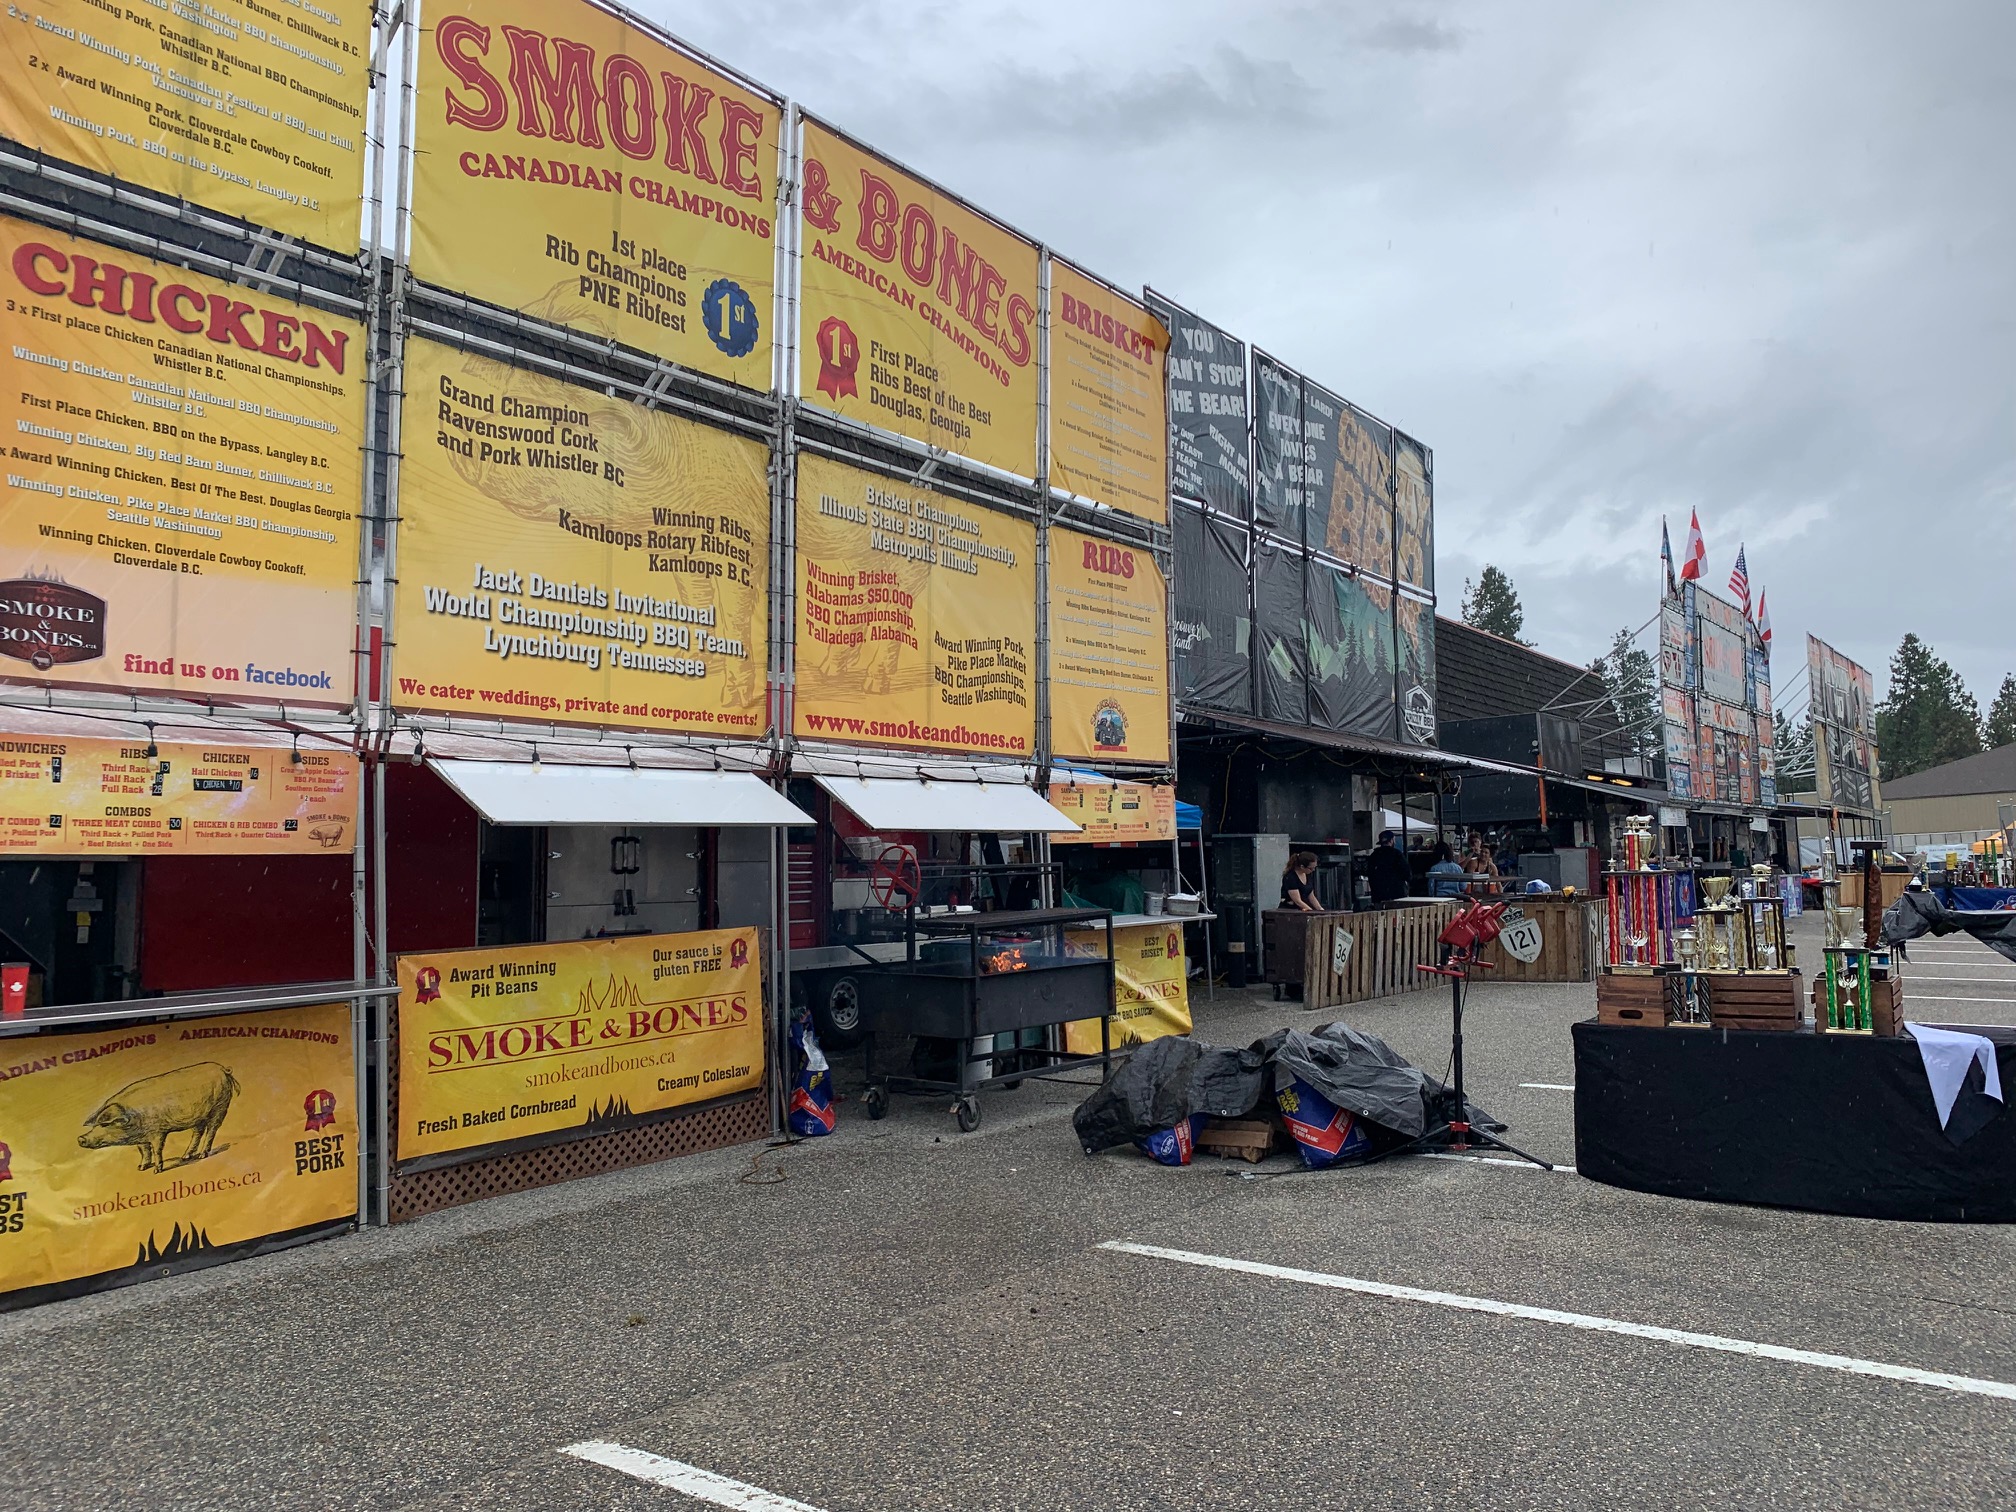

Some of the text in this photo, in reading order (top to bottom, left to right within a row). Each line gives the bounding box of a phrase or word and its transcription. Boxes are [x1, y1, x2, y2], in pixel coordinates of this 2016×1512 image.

[436, 15, 764, 203] SMOKE
[50, 105, 103, 135] Winning
[142, 140, 168, 160] BBQ
[171, 151, 185, 166] on
[189, 153, 207, 172] the
[255, 179, 299, 206] Langley
[301, 191, 320, 211] B.C.
[459, 151, 772, 239] CANADIAN CHAMPIONS
[545, 233, 687, 308] Rib Champions
[612, 230, 687, 281] 1st place
[802, 157, 1035, 368] & BONES
[12, 242, 350, 376] CHICKEN
[579, 275, 686, 334] PNE Ribfest
[718, 292, 746, 341] 1st
[811, 238, 915, 313] AMERICAN
[918, 300, 1011, 387] CHAMPIONS
[7, 299, 15, 311] 3
[19, 305, 28, 314] x
[31, 306, 62, 324] First
[65, 316, 101, 335] place
[104, 324, 154, 348] Chicken
[157, 339, 213, 363] Canadian
[216, 353, 262, 375] National
[1061, 291, 1156, 366] BRISKET
[1181, 328, 1214, 354] YOU
[153, 353, 227, 382] Whistler B.C.
[870, 340, 939, 382] First Place
[1170, 356, 1202, 382] AN'T
[1209, 363, 1243, 387] STOP
[439, 374, 589, 428] Grand Champion
[869, 363, 993, 427] Ribs Best of the Best
[869, 386, 971, 439] Douglas, Georgia
[1199, 392, 1246, 418] BEAR!
[438, 400, 599, 453] Ravenswood Cork
[1209, 424, 1235, 458] RIGHT
[437, 430, 625, 488] and Pork Whistler BC
[652, 507, 755, 547] Winning Ribs,
[865, 485, 983, 537] Brisket Champions,
[558, 508, 755, 568] Kamloops Rotary Ribfest,
[818, 494, 1018, 569] Illinois State BBQ Championship,
[870, 531, 978, 576] Metropolis Illinois
[1082, 540, 1134, 579] RIBS
[648, 554, 754, 590] Kamloops B.C.
[806, 558, 855, 591] Winning
[0, 599, 95, 624] SMOKE
[473, 563, 715, 627] Jack Daniels Invitational
[806, 580, 864, 607] Alabamas
[37, 618, 51, 630] &
[423, 585, 748, 659] World Championship BBQ Team,
[806, 598, 917, 632] BBQ Championship,
[483, 626, 706, 678] Lynchburg Tennessee
[805, 618, 919, 650] Talladega, Alabama
[124, 653, 332, 690] find us on facebook
[399, 677, 759, 728] We cater weddings, private and corporate events!
[805, 713, 1026, 751] www.smokeandbones.ca
[121, 748, 149, 759] RIBS
[202, 752, 250, 764] CHICKEN
[302, 757, 330, 766] SIDES
[101, 785, 144, 794] Full Rack
[102, 774, 146, 783] Half Rack
[191, 768, 243, 778] Half Chicken
[72, 819, 162, 828] THREE MEAT COMBO
[105, 806, 152, 817] COMBOS
[193, 820, 227, 829] CHICKEN
[237, 821, 250, 829] RIB
[252, 821, 278, 829] COMBO
[652, 944, 722, 962] Our sauce is
[1141, 947, 1163, 959] BRISKET
[1145, 937, 1159, 947] BEST
[1336, 943, 1346, 963] 36
[1508, 927, 1537, 951] 121
[450, 960, 556, 983] Award Winning
[653, 958, 721, 981] gluten FREE
[471, 978, 538, 998] Pit Beans
[1136, 982, 1180, 1001] BONES
[62, 1034, 156, 1064] CHAMPIONS
[180, 1027, 339, 1044] AMERICAN CHAMPIONS
[428, 996, 747, 1068] SMOKE & BONES
[525, 1049, 676, 1089] smokeandbones.ca
[657, 1063, 750, 1093] Creamy Coleslaw
[417, 1094, 576, 1136] Fresh Baked Cornbread
[295, 1134, 344, 1158] BEST
[296, 1152, 345, 1176] PORK
[73, 1169, 261, 1220] smokeandbones.ca
